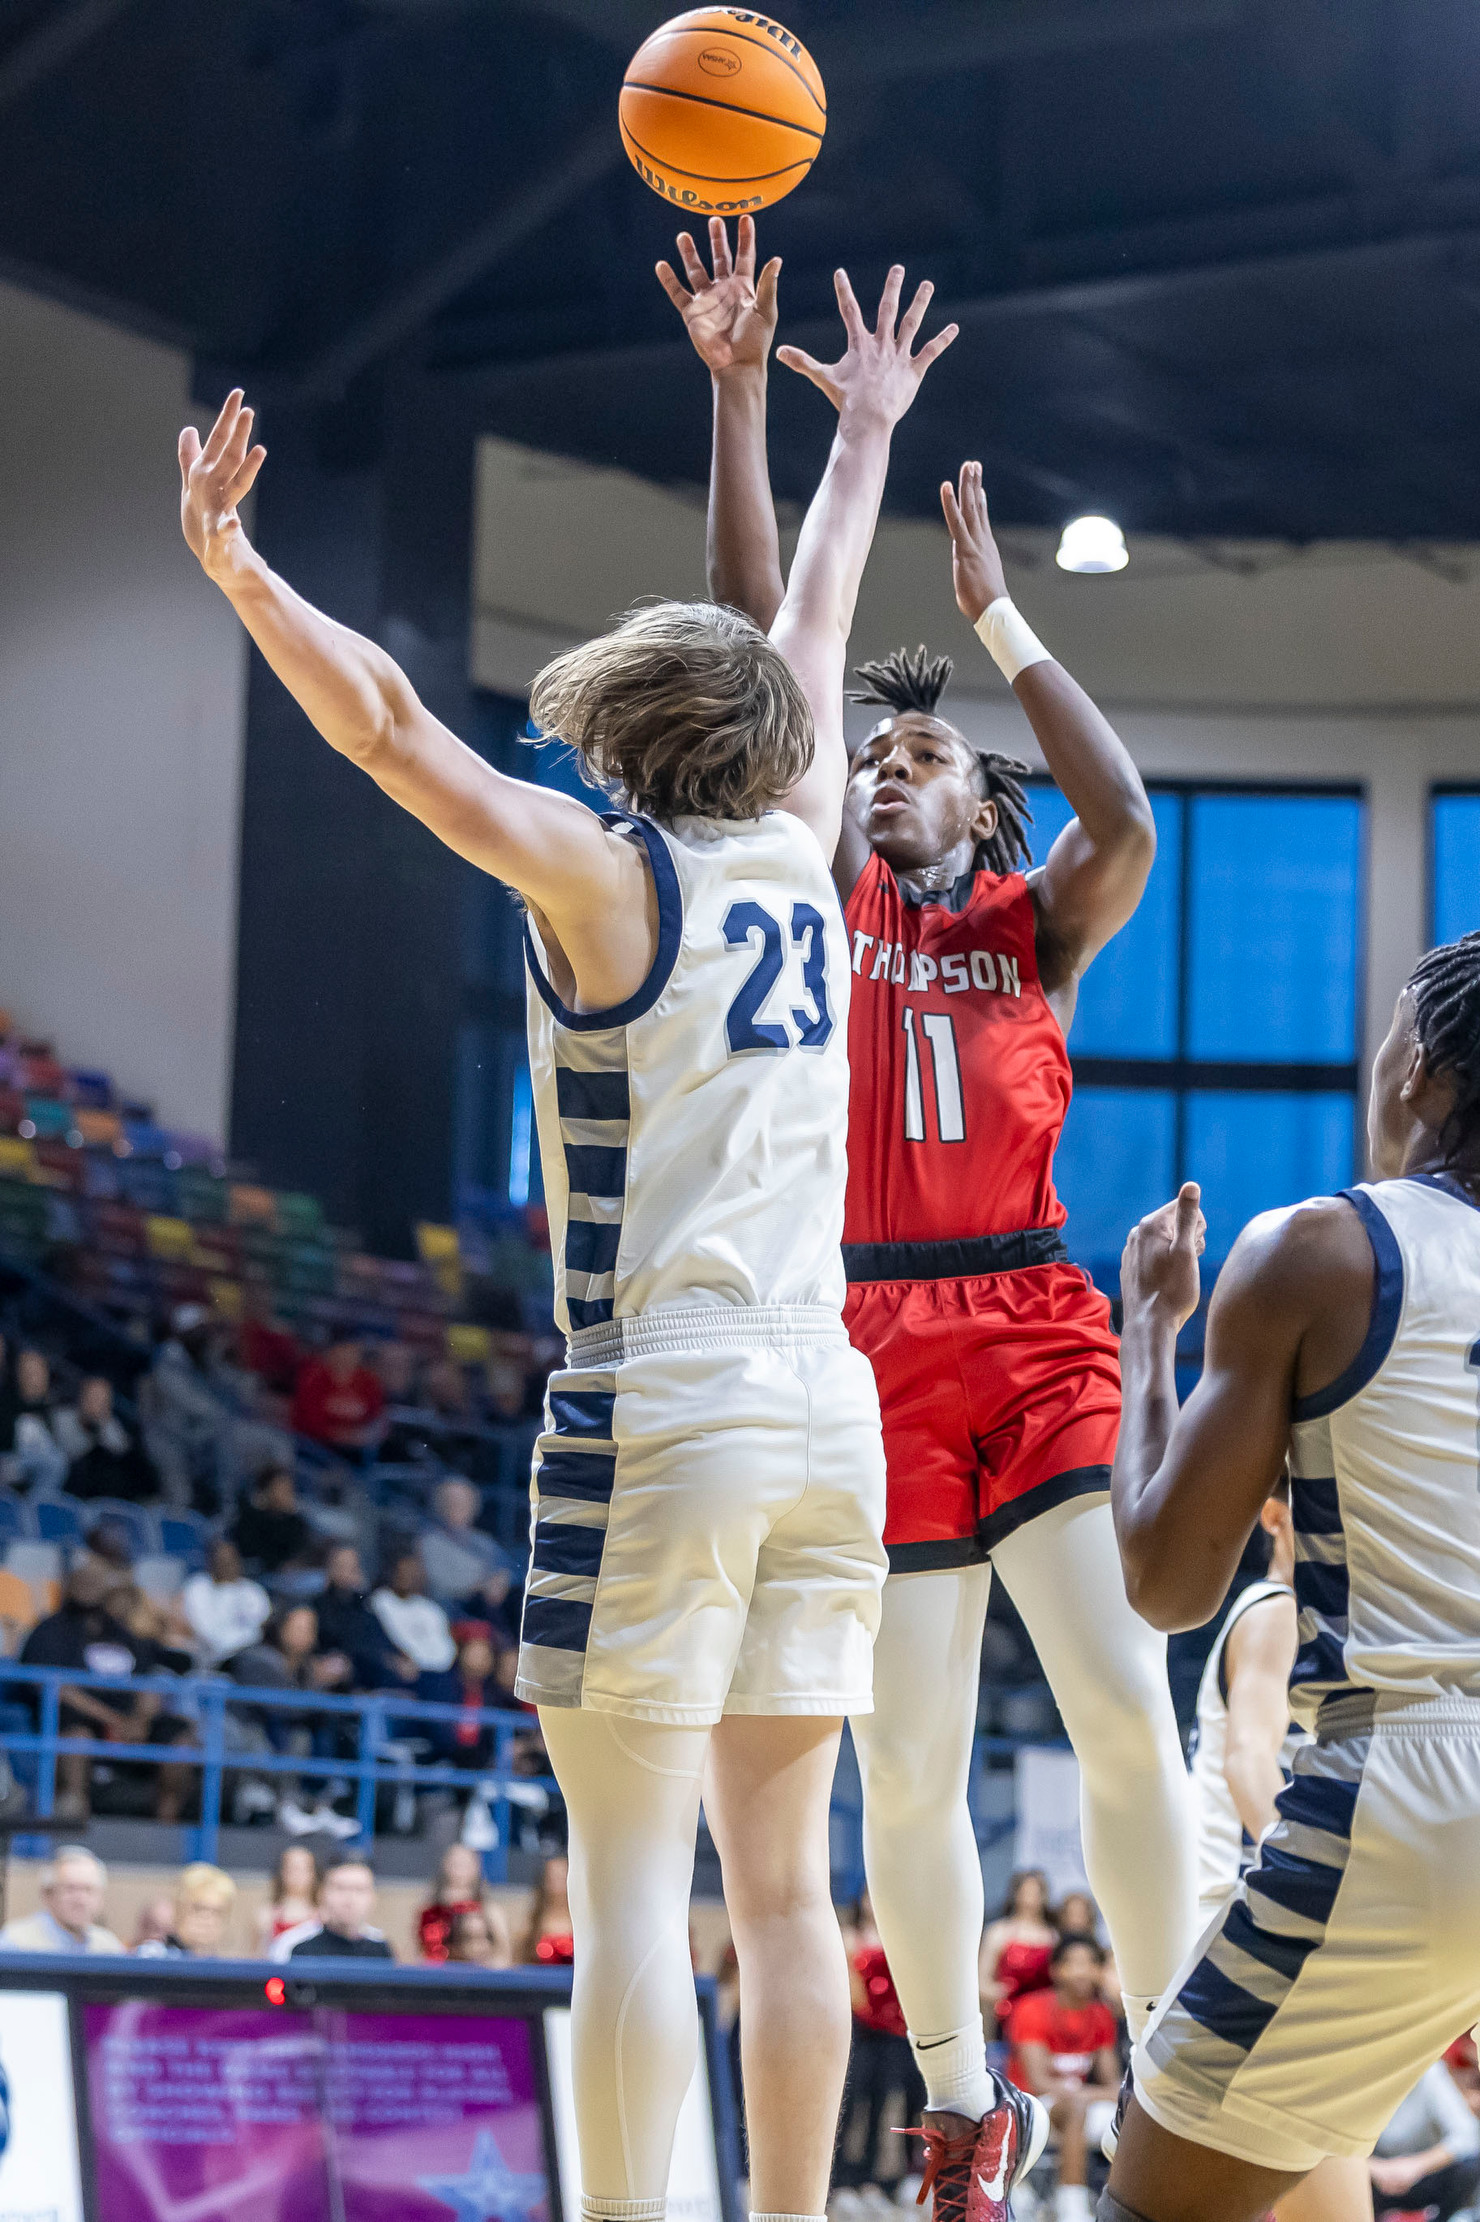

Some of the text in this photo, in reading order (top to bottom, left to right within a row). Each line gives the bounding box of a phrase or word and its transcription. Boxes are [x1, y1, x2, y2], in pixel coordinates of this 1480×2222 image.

[635, 154, 762, 211] Wilson
[718, 898, 837, 1060] 23
[901, 1005, 966, 1144] 11
